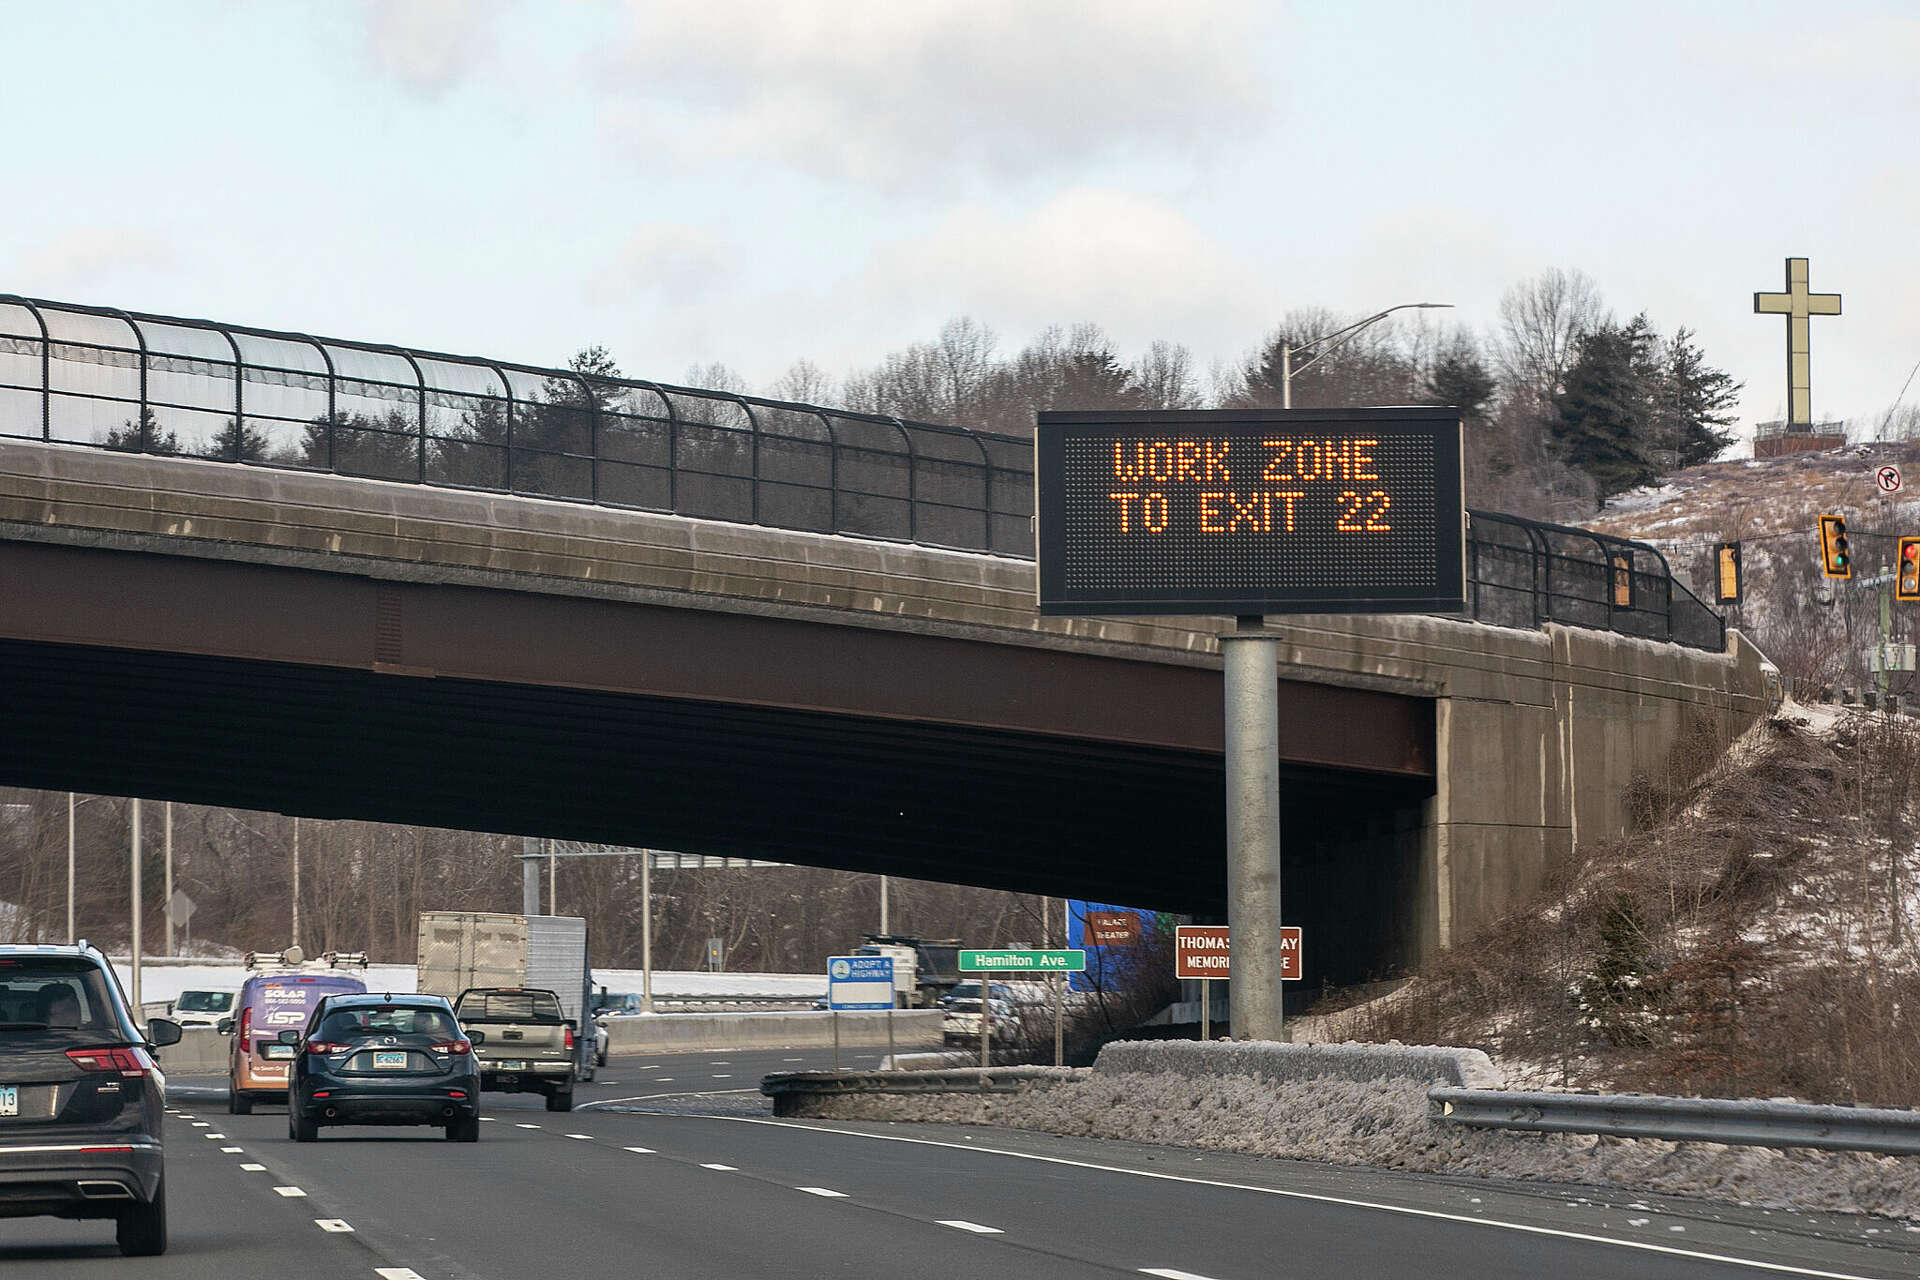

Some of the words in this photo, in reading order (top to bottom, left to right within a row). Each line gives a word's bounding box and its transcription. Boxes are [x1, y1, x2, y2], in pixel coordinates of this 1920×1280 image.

[1114, 441, 1230, 482] WORK
[1262, 440, 1379, 480] ZONE
[1109, 492, 1169, 533] TO
[1200, 491, 1304, 533] EXIT
[1337, 490, 1391, 531] 22
[975, 954, 1033, 967] Hamilton
[1040, 954, 1068, 967] Ave.
[1187, 956, 1230, 969] MEMORI
[264, 990, 306, 998] SOLAR
